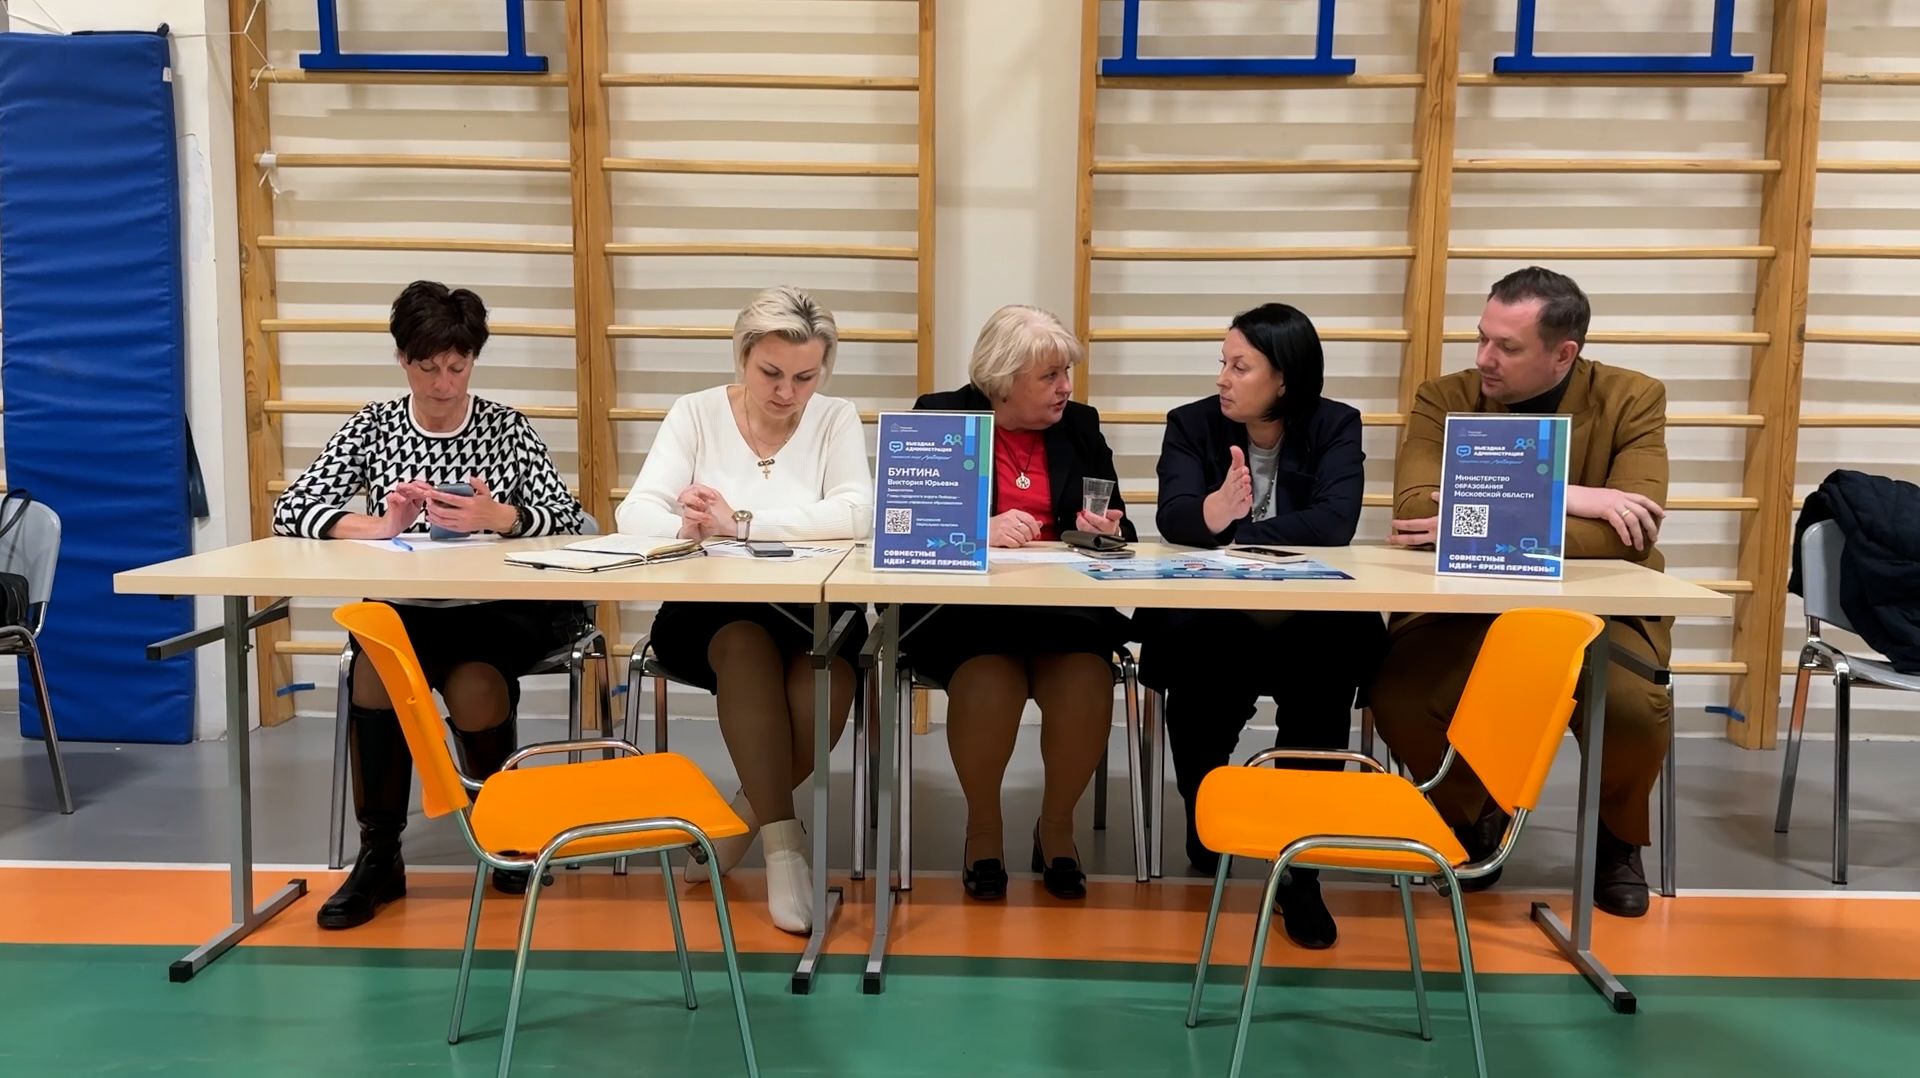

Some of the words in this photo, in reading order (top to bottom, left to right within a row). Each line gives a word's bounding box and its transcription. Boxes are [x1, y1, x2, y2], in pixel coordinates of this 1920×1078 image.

[888, 467, 941, 477] БУНТИНА
[887, 478, 924, 486] Виктория
[924, 479, 959, 487] Юрьевна
[1448, 554, 1505, 562] СОВМЕСТНЫЕ
[1478, 563, 1505, 571] ЯРКИЕ
